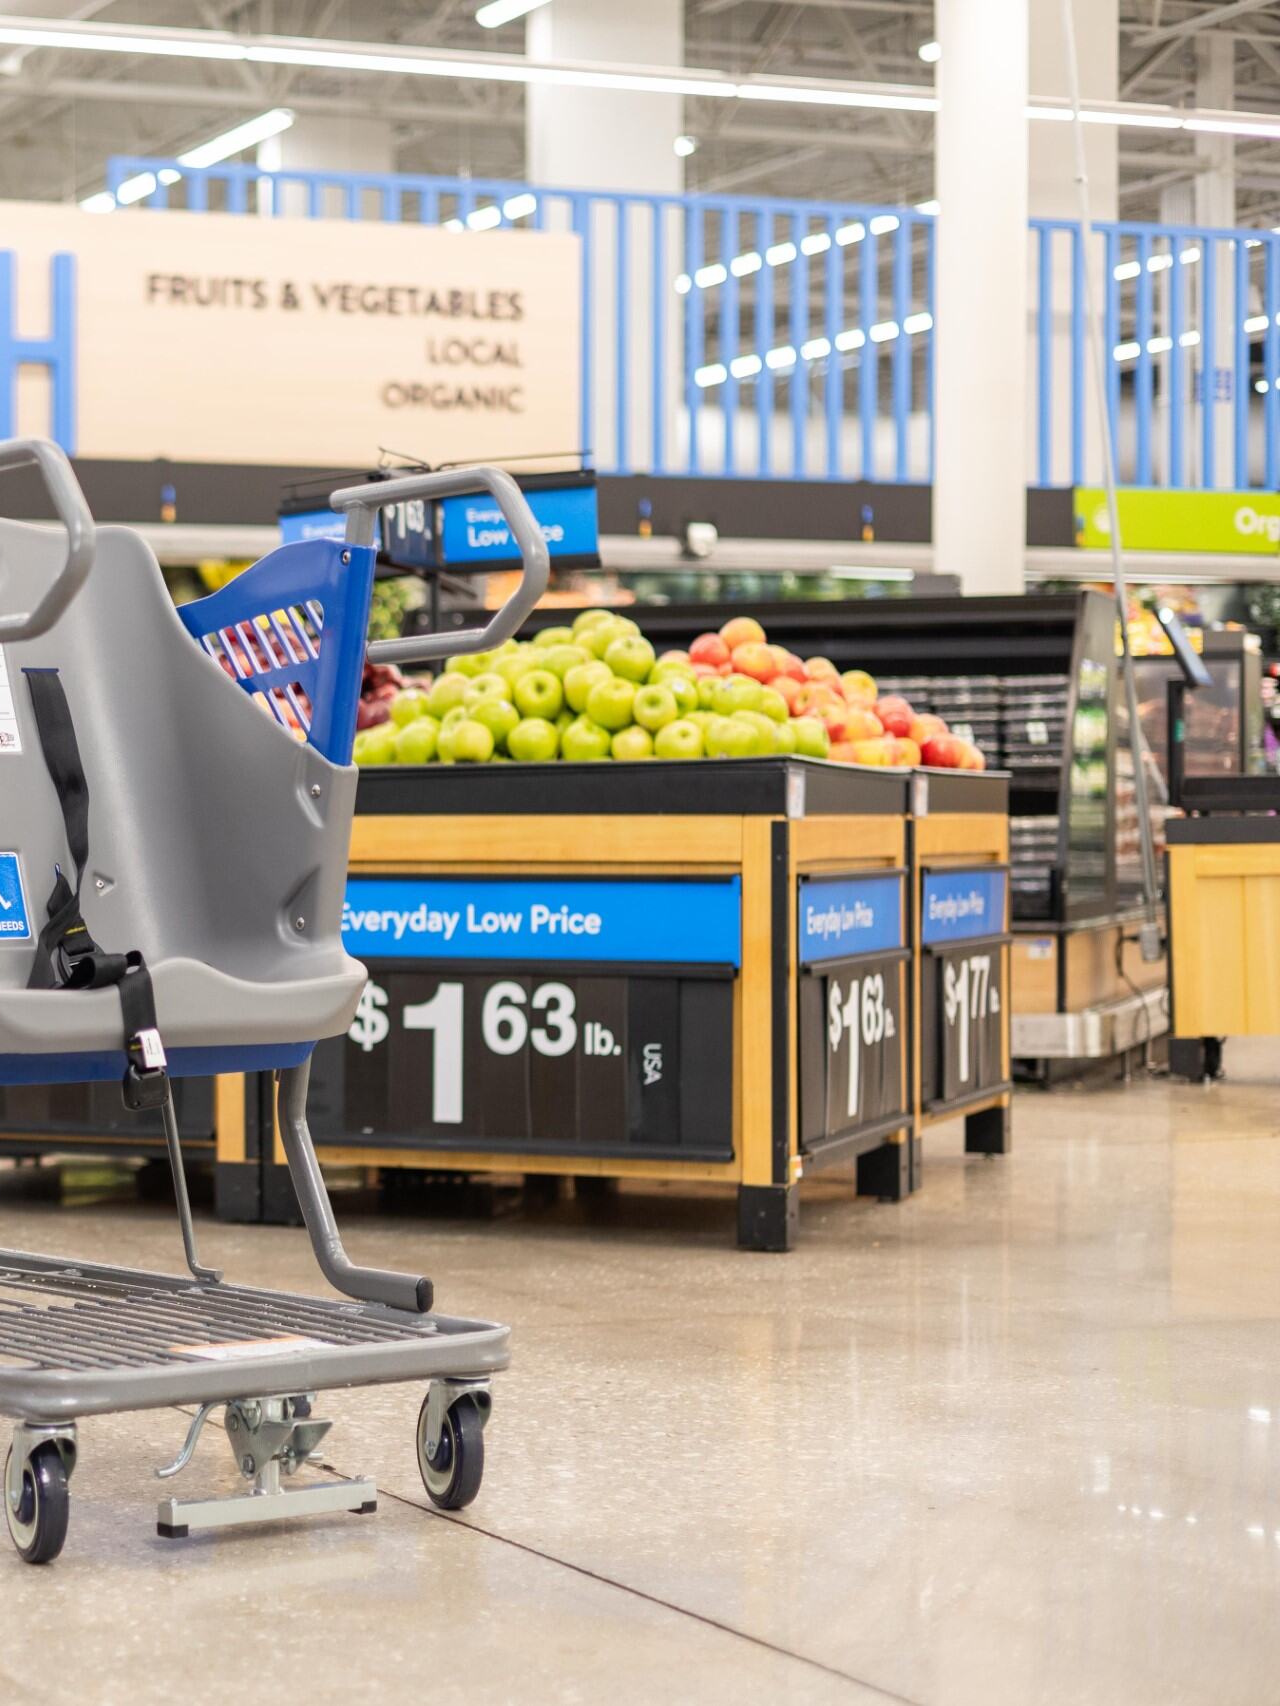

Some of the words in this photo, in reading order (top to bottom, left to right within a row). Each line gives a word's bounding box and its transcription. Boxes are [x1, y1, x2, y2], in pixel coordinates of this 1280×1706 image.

[146, 273, 267, 311] FRUITS
[282, 281, 303, 313] &
[311, 282, 525, 321] VEGETABLES
[426, 336, 525, 368] LOCAL
[380, 380, 525, 414] ORGANIC
[467, 525, 509, 548] Low
[467, 903, 523, 934] Low
[530, 904, 603, 935] Price
[584, 1022, 623, 1057] lb.
[642, 1043, 664, 1087] USA
